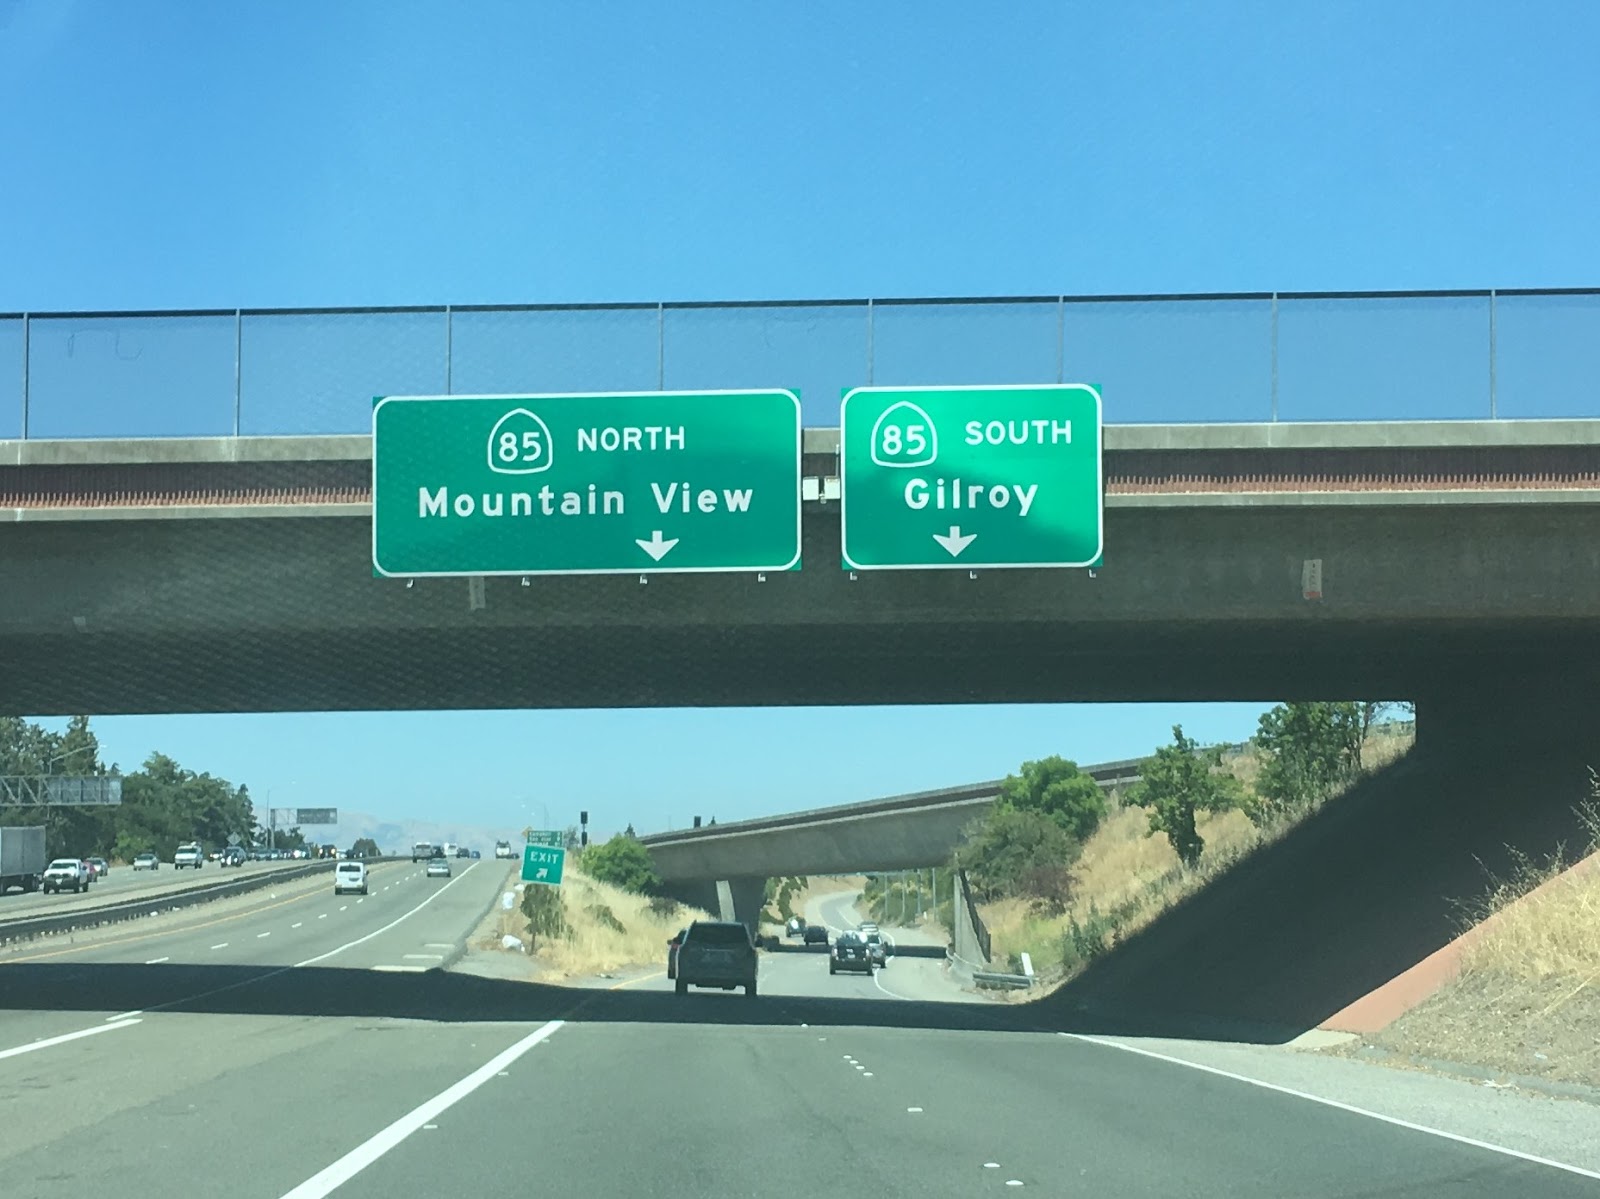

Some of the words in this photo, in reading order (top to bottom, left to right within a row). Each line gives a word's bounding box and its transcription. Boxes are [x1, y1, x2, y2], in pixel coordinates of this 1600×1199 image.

[499, 432, 542, 462] 85
[577, 426, 686, 451] NORTH
[883, 425, 926, 455] 85
[964, 419, 1072, 445] SOUTH
[418, 484, 625, 518] Mountain
[651, 482, 754, 514] View
[904, 478, 1039, 516] Gilroy
[530, 851, 559, 864] EXIT
